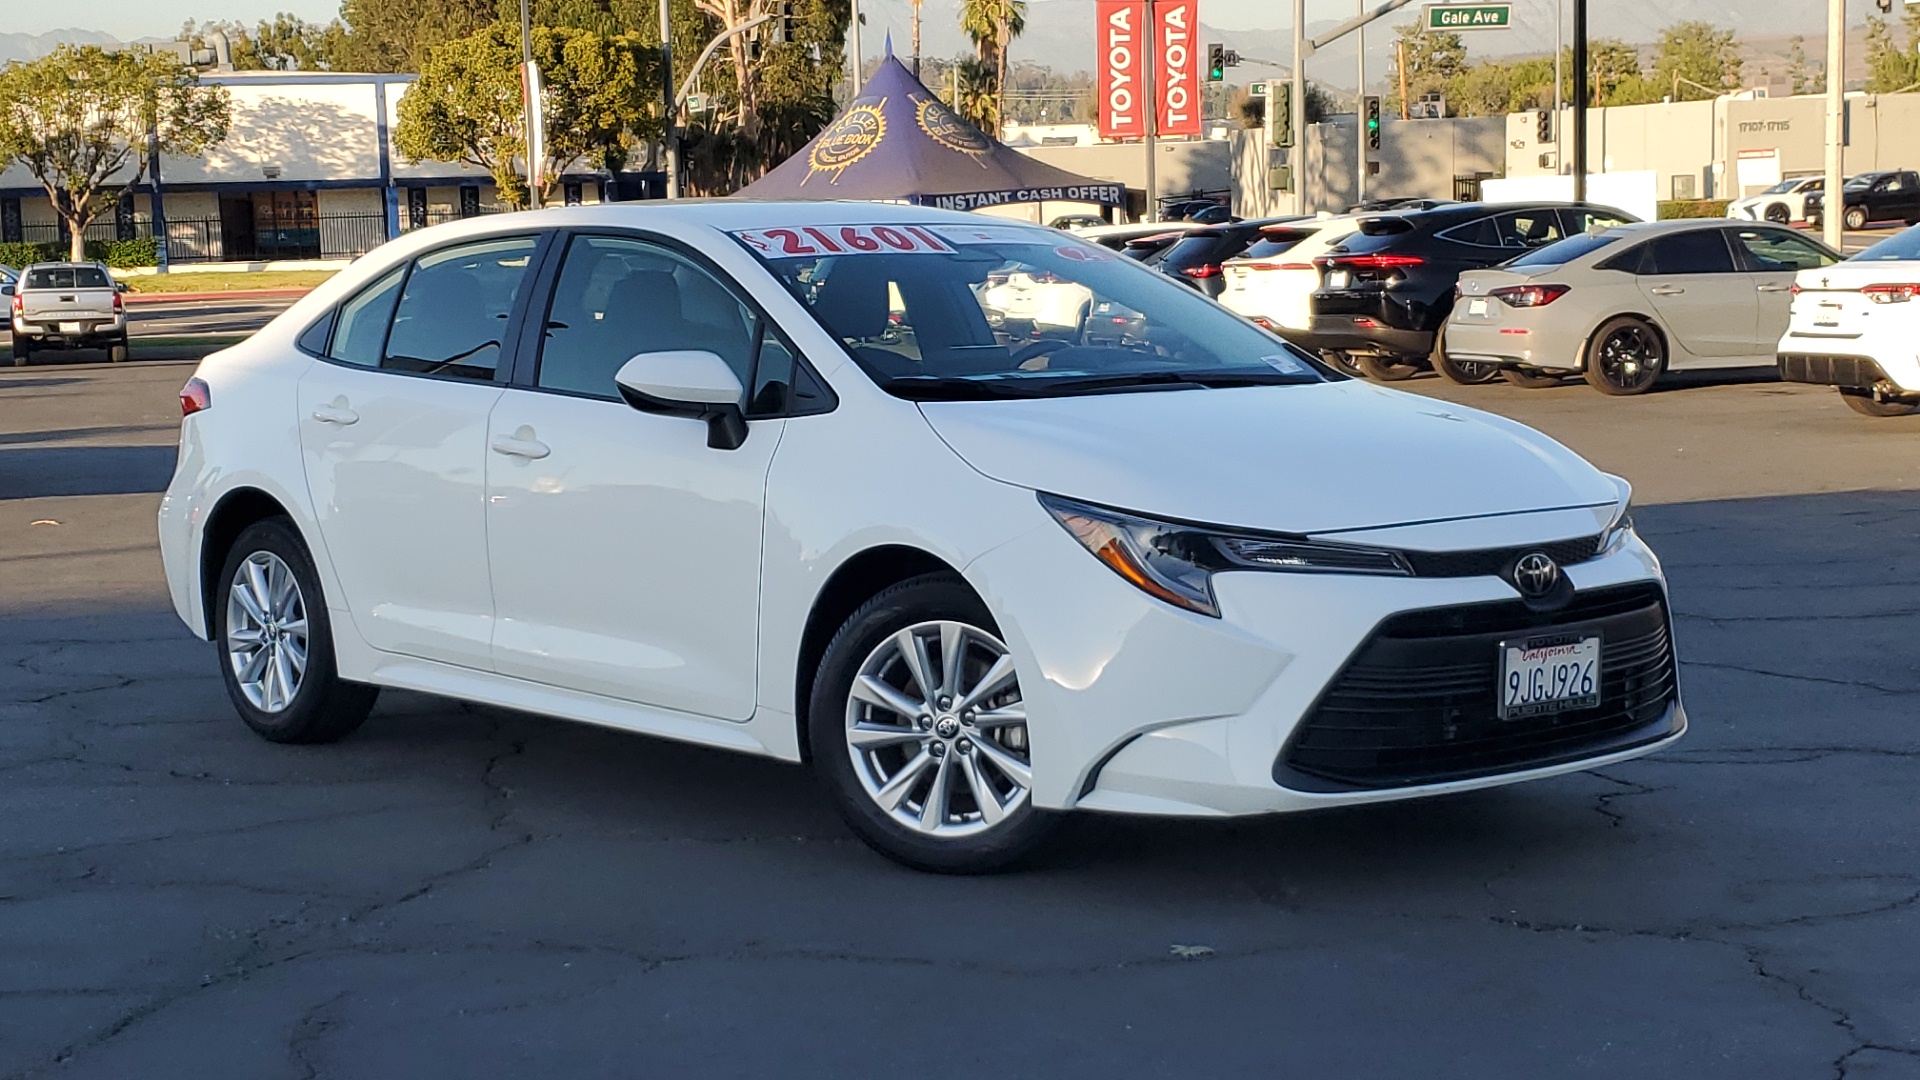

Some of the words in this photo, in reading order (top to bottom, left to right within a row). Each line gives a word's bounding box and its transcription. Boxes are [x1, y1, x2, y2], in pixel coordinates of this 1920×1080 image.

[1441, 11, 1470, 24] Gale
[1472, 10, 1499, 23] Ave
[1109, 7, 1132, 130] TOYOTA
[1165, 5, 1187, 128] TOYOTA
[835, 113, 877, 133] KELLEY
[819, 134, 846, 149] BLUE
[844, 134, 875, 145] BOOK
[935, 191, 1012, 210] INSTANT
[1016, 187, 1063, 200] CASH
[1067, 185, 1120, 203] OFFER
[1522, 646, 1581, 664] California
[1509, 660, 1594, 706] 9JGJ926
